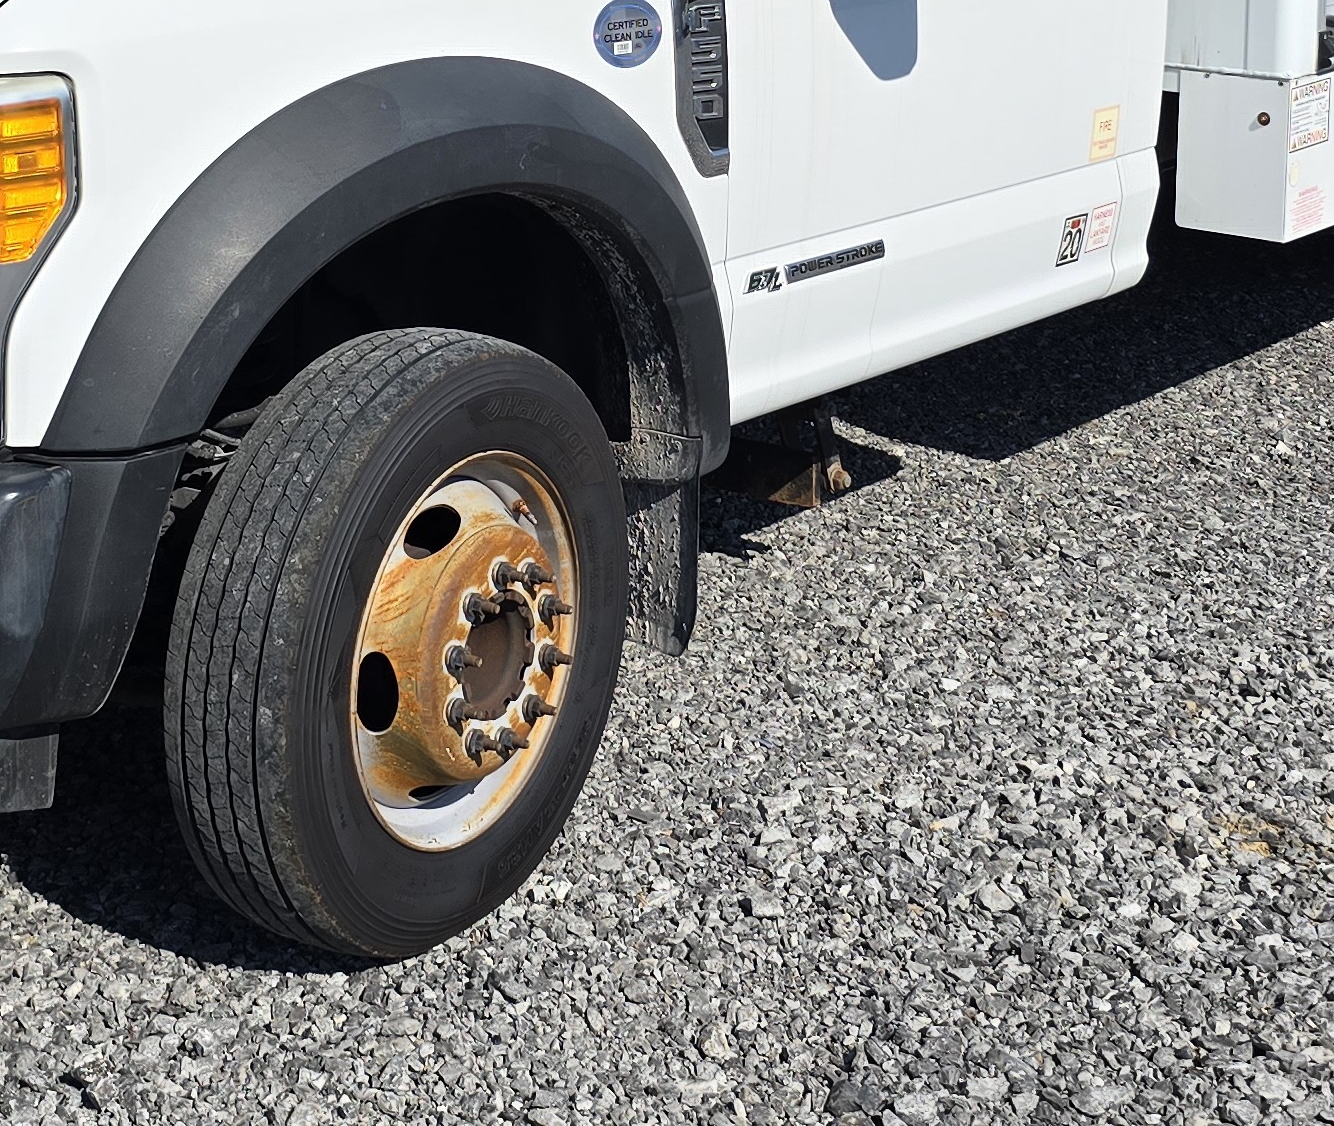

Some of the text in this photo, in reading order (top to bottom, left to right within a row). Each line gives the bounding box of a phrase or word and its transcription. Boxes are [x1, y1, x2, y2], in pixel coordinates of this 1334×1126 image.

[607, 18, 649, 31] CERTIFIED
[603, 29, 653, 43] CLEAN IDLE
[1298, 80, 1329, 100] WARNING
[1296, 128, 1327, 148] WARNING
[1059, 228, 1082, 261] 20
[790, 256, 834, 277] POWER
[835, 241, 885, 265] STROKE
[500, 395, 592, 463] Hankook
